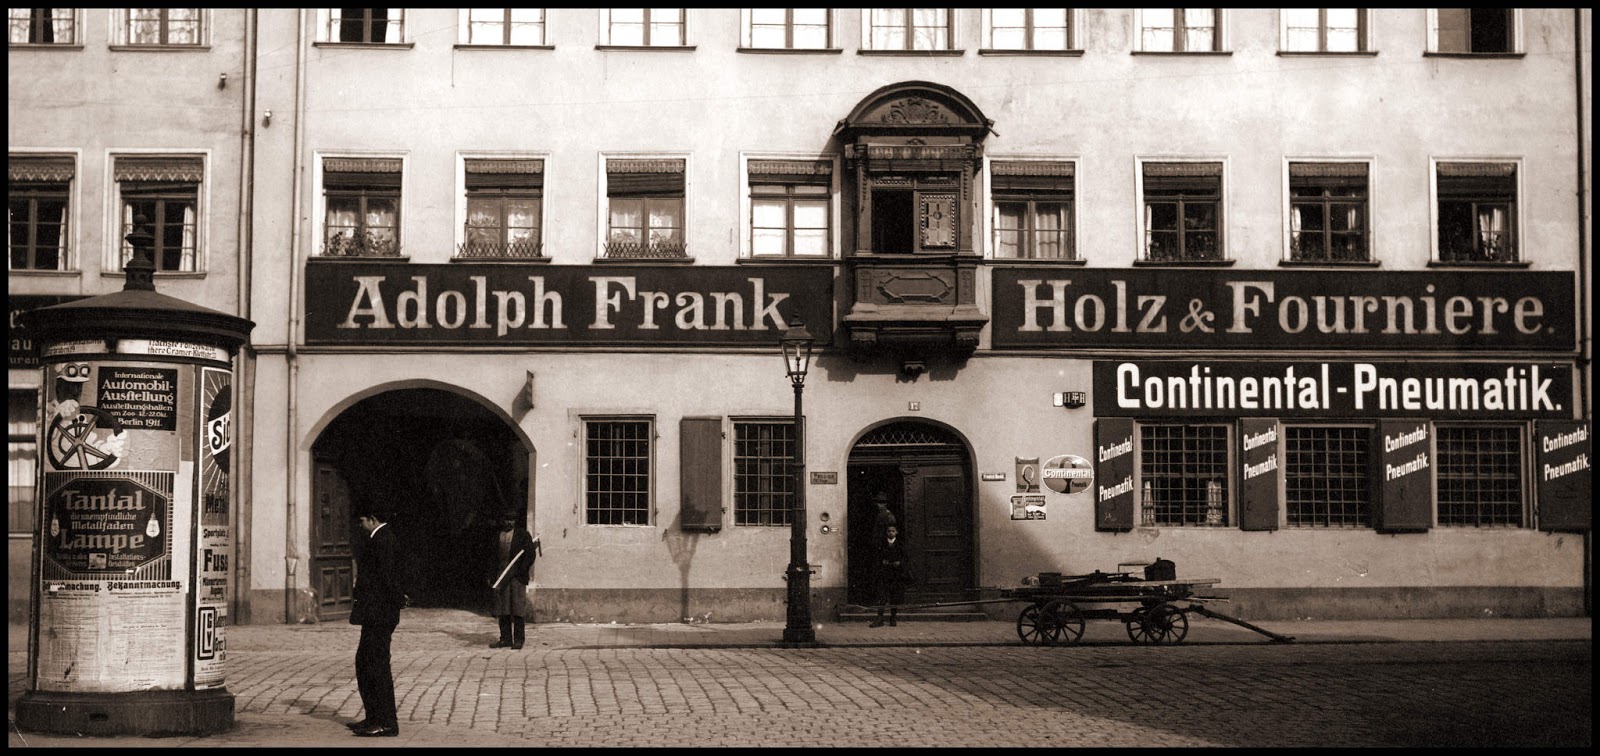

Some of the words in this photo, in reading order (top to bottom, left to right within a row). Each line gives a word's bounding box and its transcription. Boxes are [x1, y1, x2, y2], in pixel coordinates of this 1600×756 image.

[336, 275, 568, 337] Adolph
[1017, 279, 1168, 333] Holz
[1179, 298, 1215, 333] &
[1225, 280, 1554, 335] Fourniere.
[114, 371, 164, 379] Internationale
[102, 379, 174, 391] Automobil-
[117, 417, 144, 426] Berlin
[1044, 468, 1091, 478] Continental
[61, 488, 146, 511] Tantal
[71, 521, 134, 532] Metallfaden
[59, 528, 145, 553] Lampe
